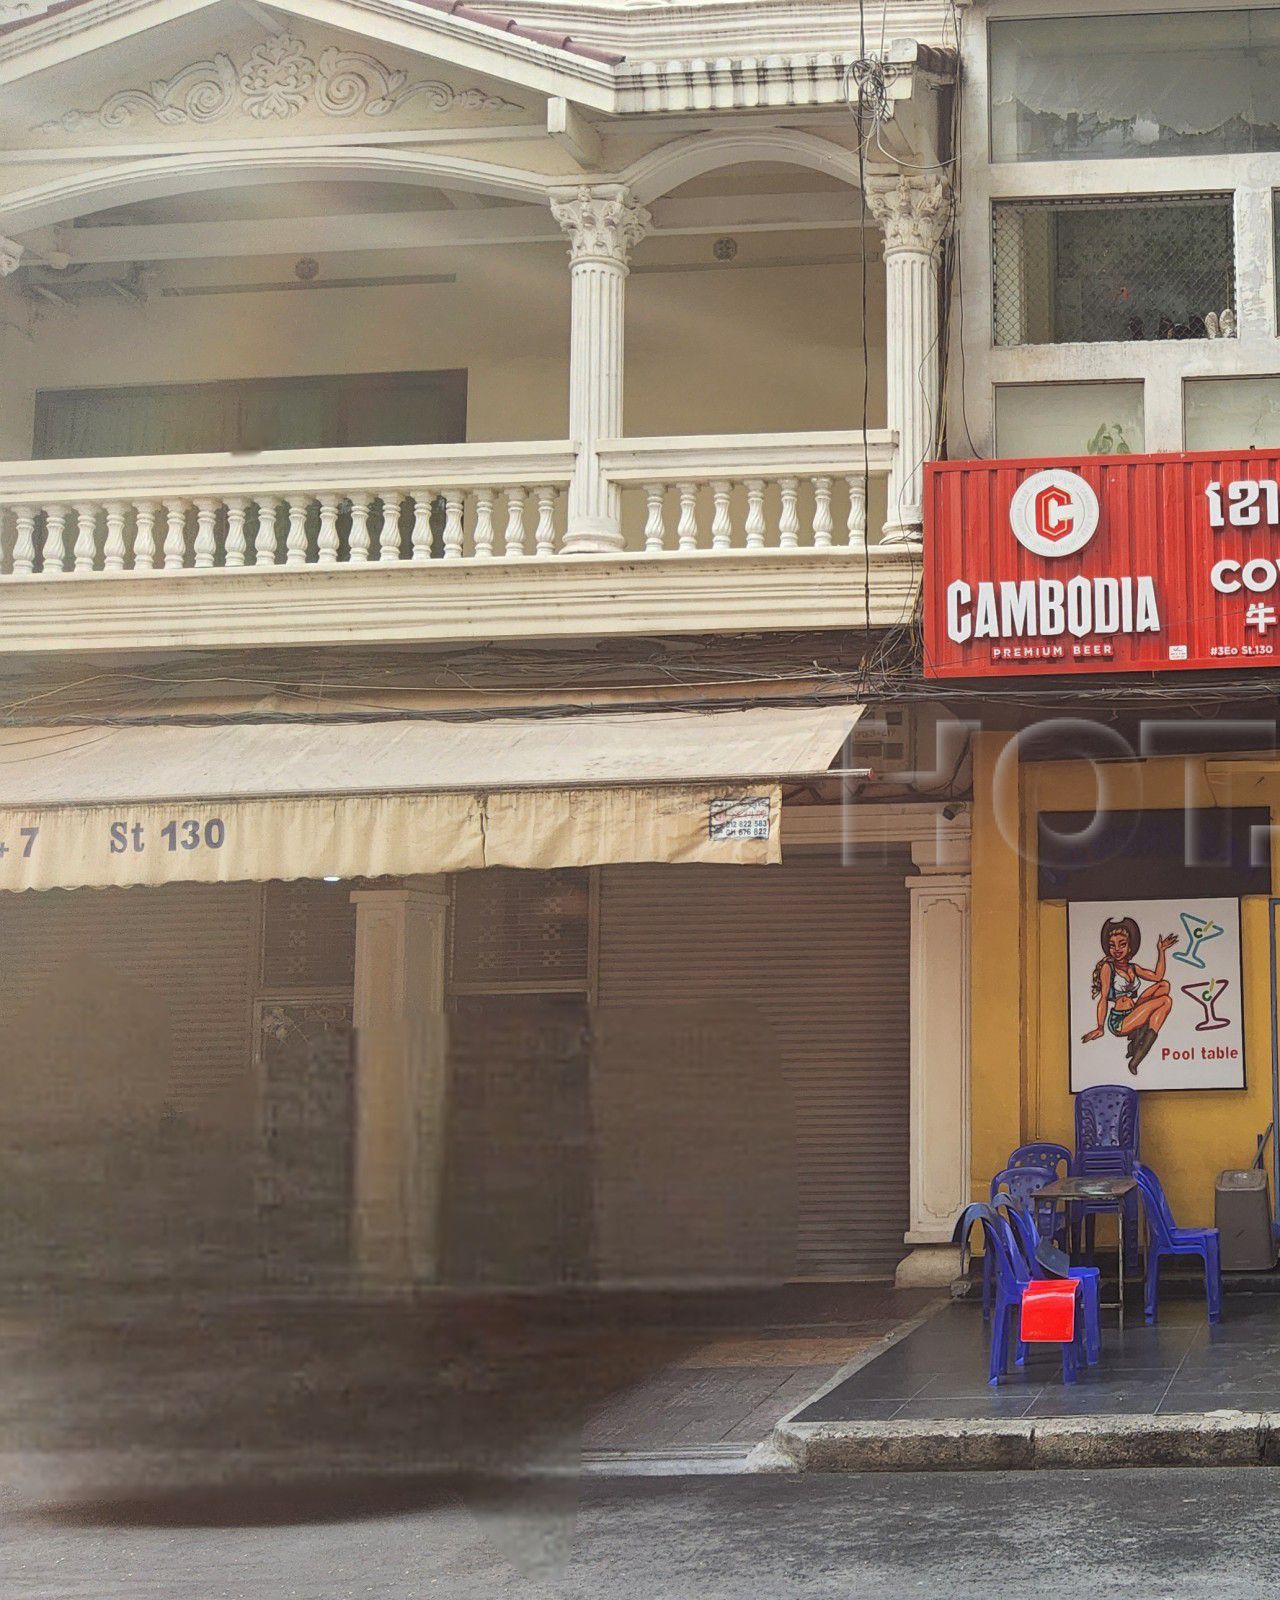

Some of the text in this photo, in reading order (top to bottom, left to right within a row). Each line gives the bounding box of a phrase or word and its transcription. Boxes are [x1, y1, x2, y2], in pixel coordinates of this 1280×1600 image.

[947, 575, 1161, 644] CAMBODIA
[993, 644, 1112, 658] PREMIUM BEER
[20, 827, 39, 857] 7
[110, 818, 225, 853] St 130
[1161, 1046, 1239, 1061] Pool table
